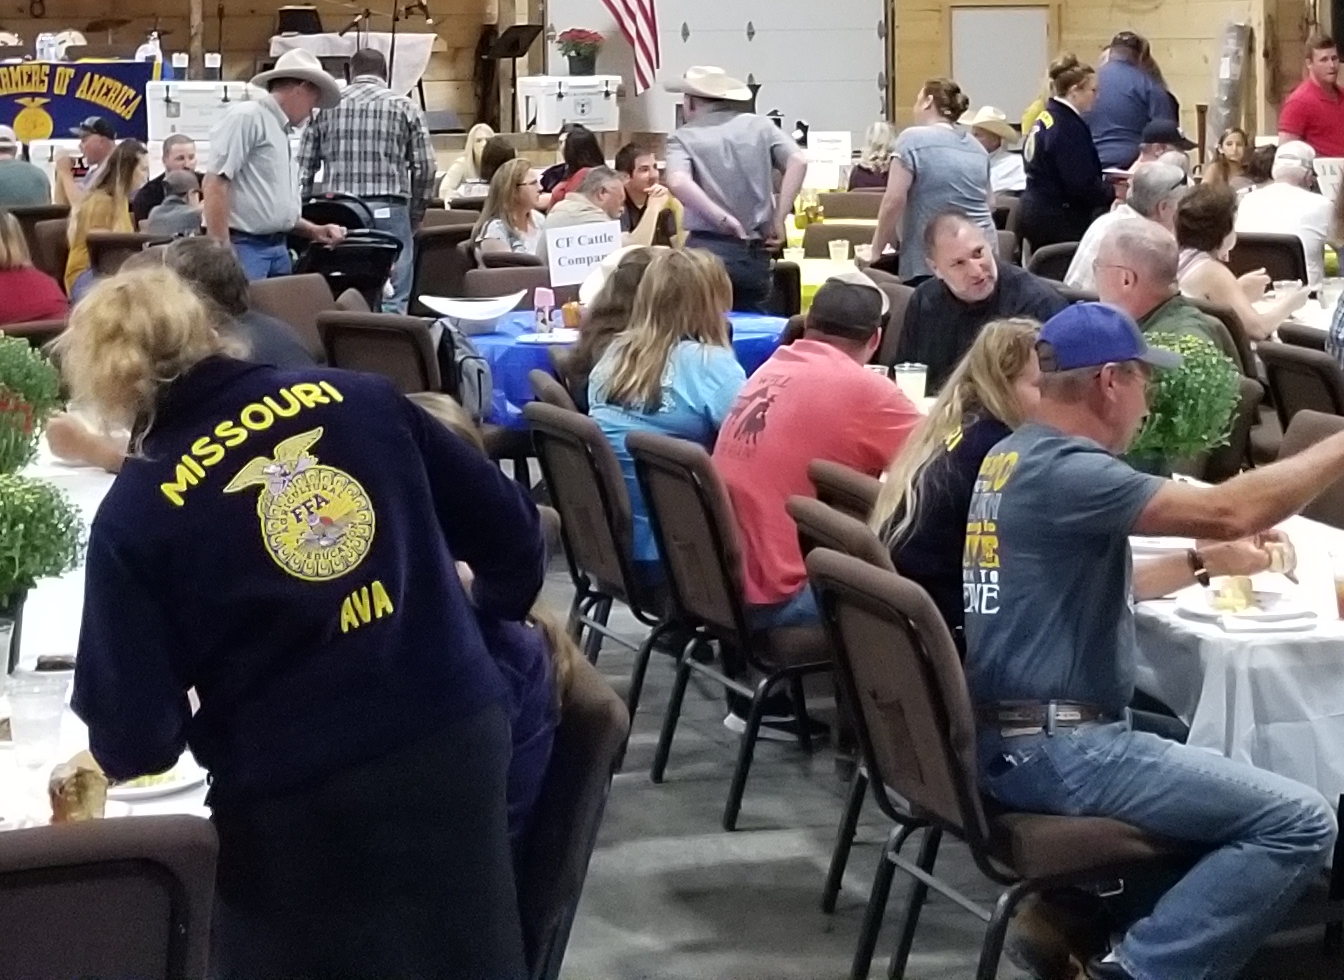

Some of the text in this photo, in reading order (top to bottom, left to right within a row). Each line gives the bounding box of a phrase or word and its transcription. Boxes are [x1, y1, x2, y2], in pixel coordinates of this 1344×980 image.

[53, 67, 75, 95] OF
[75, 72, 142, 121] AMERICA
[555, 233, 614, 249] CF Cattle
[161, 381, 343, 506] MISSOURI
[291, 493, 331, 524] FFA
[979, 569, 999, 583] TO
[341, 580, 394, 633] AVA
